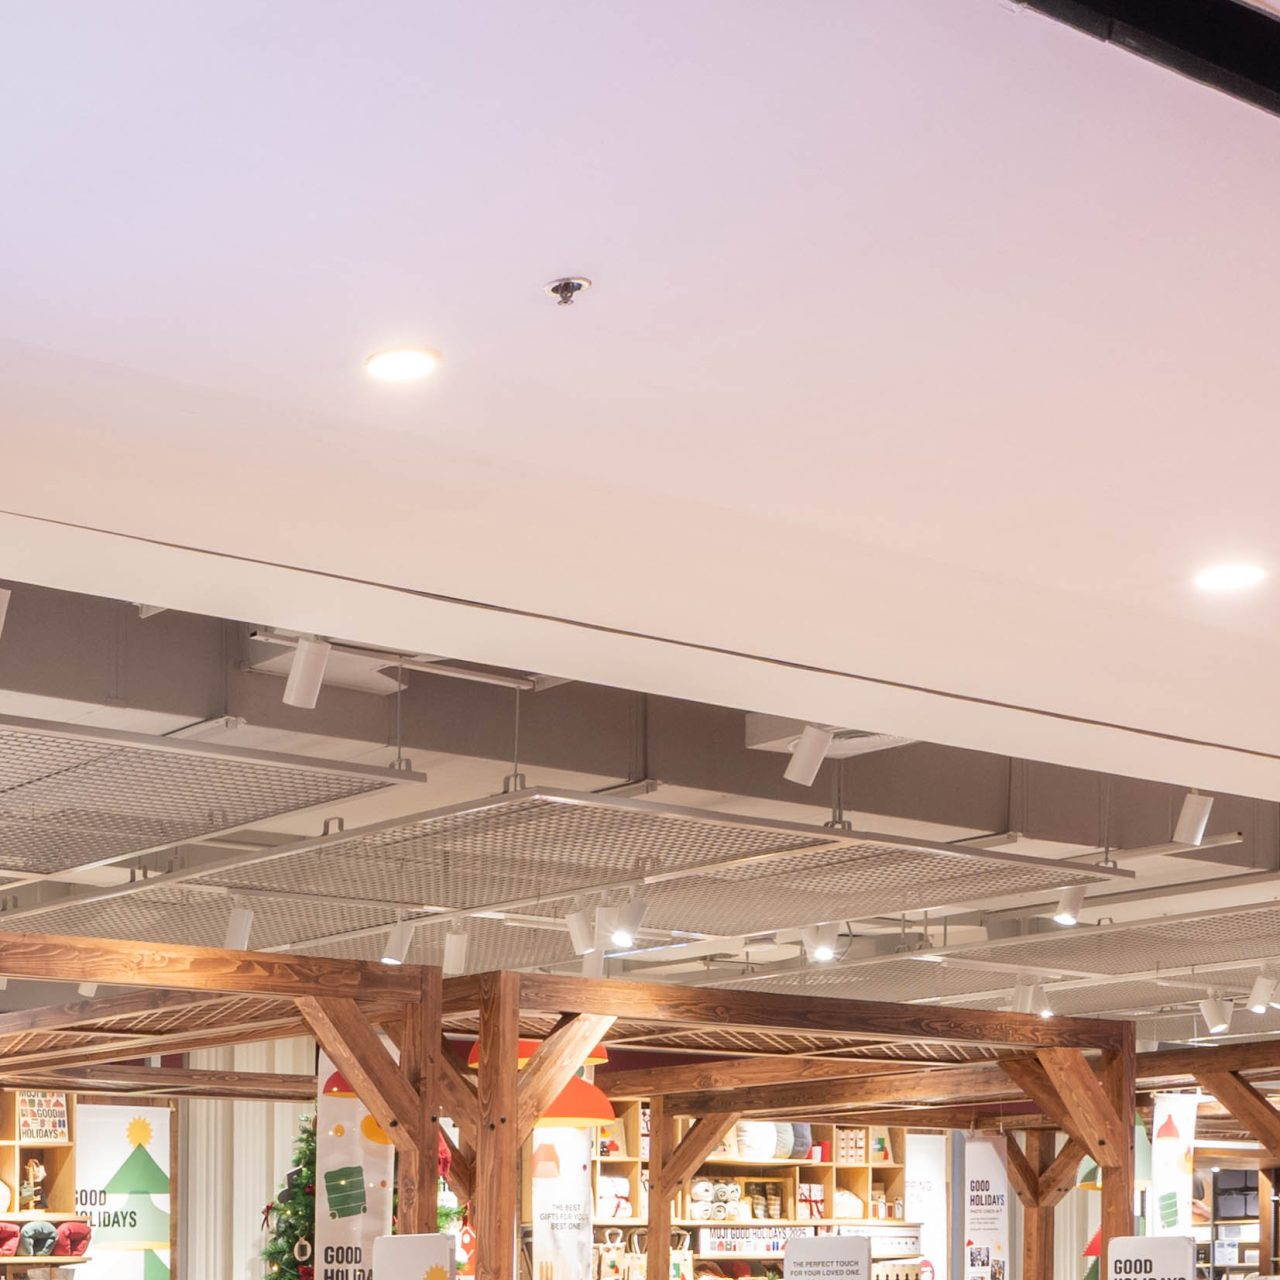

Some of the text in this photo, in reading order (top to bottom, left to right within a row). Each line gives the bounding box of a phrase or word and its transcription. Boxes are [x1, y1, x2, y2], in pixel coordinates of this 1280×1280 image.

[36, 1108, 57, 1118] GOOD
[21, 1128, 58, 1139] HOLIDAYS
[970, 1180, 990, 1191] GOOD
[75, 1190, 107, 1206] OOD
[970, 1195, 1004, 1206] HOLIDAYS
[76, 1210, 137, 1228] LIDAYS
[710, 1228, 728, 1239] MUJI
[730, 1228, 750, 1239] GOOD
[752, 1228, 787, 1239] HOLIDAYS
[324, 1246, 362, 1264] GOOD
[1114, 1259, 1152, 1275] GOOD
